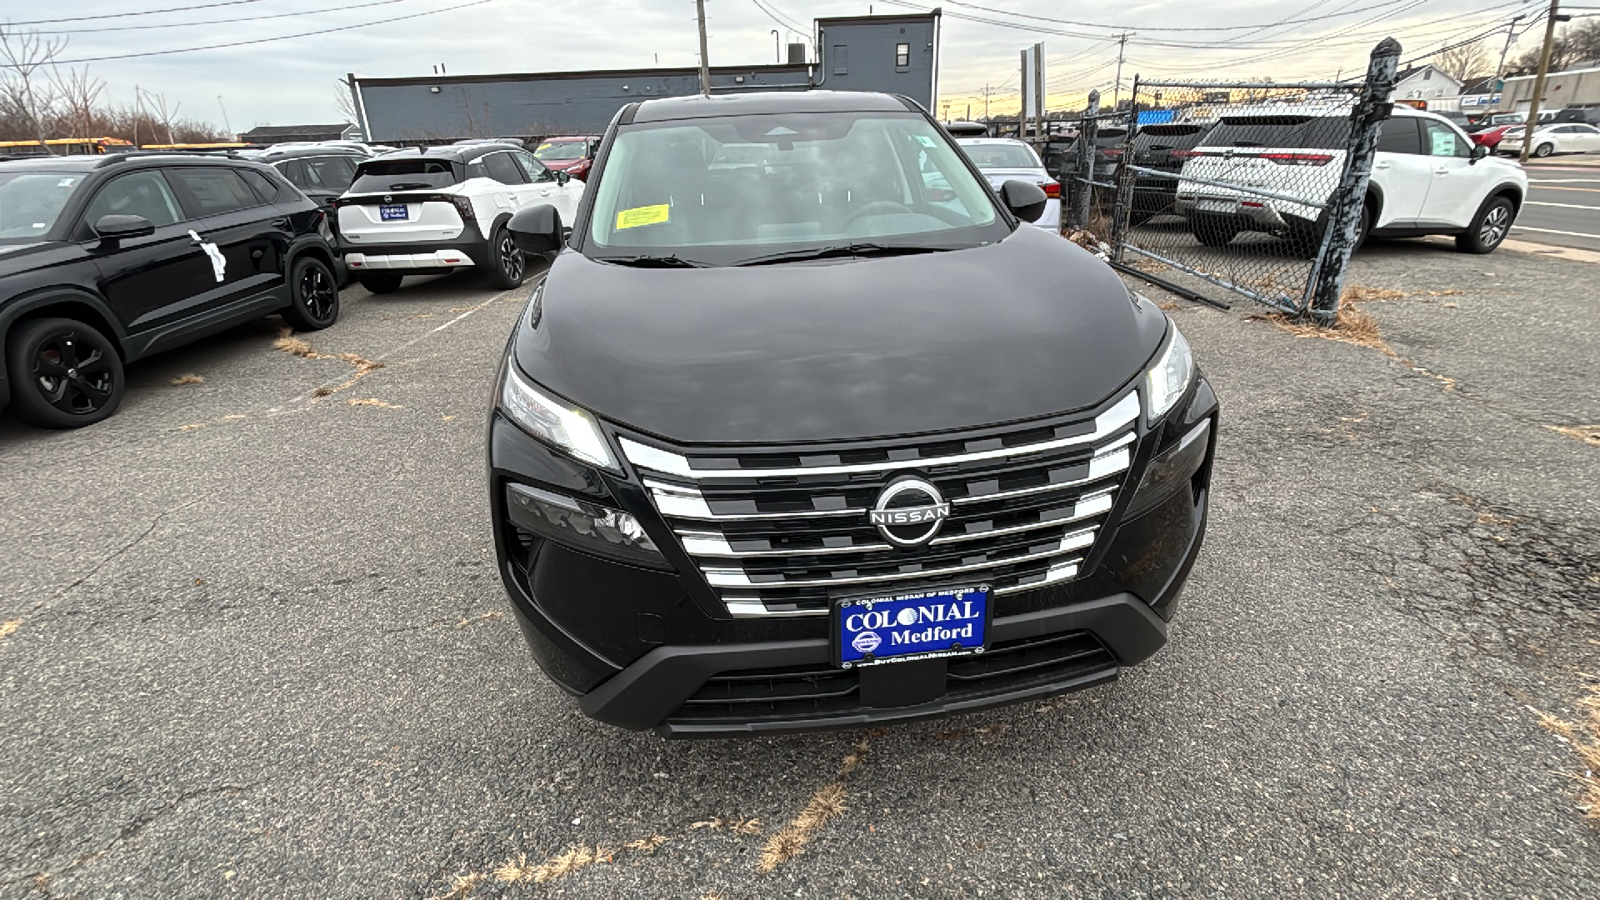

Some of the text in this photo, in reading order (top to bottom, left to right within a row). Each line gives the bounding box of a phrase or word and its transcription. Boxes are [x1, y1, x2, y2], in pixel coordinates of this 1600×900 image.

[871, 506, 949, 523] NISSAN
[856, 597, 893, 606] COLONIAL
[896, 593, 924, 601] NISSAN
[938, 588, 974, 596] MEDFORD
[846, 601, 979, 632] COLONIAL
[891, 623, 973, 645] Medford
